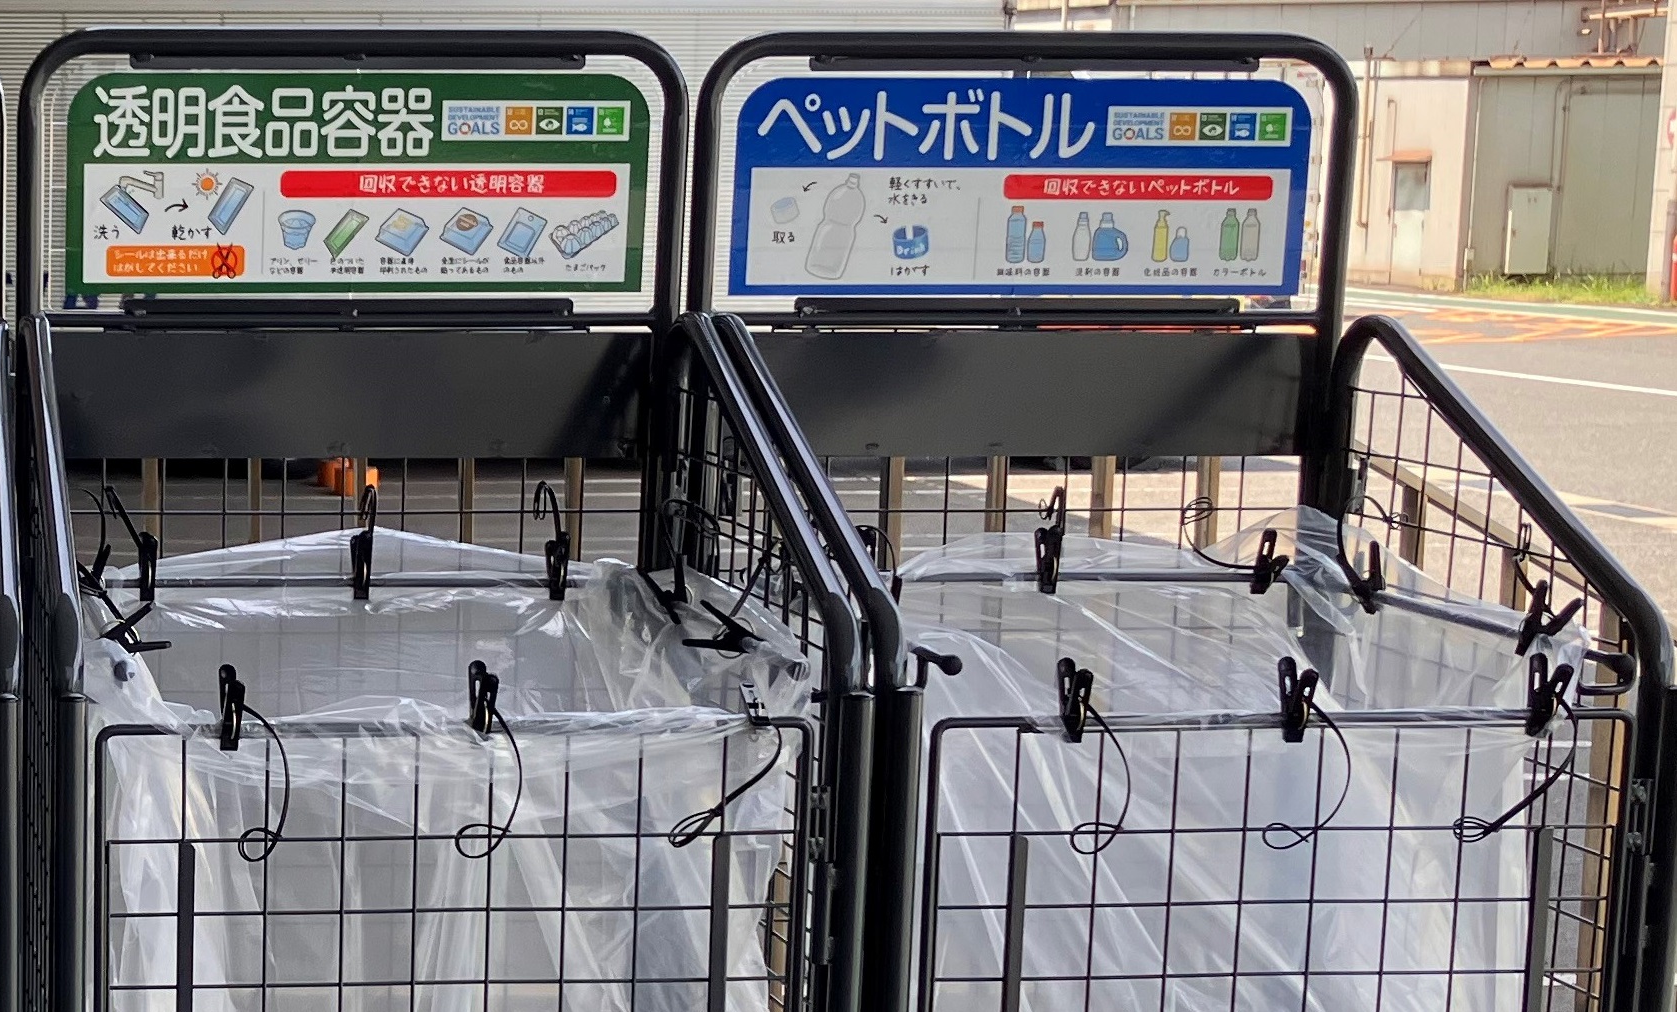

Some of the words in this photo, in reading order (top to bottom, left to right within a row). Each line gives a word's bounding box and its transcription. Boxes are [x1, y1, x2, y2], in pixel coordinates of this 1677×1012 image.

[94, 86, 434, 158] 透明食品容器
[447, 122, 500, 135] GOALS
[757, 88, 1095, 160] ペットボトル
[1112, 127, 1165, 140] GOALS
[359, 174, 545, 194] 回収できない透明容器
[1043, 178, 1239, 196] 回収できないペットボトル
[93, 224, 121, 240] 洗う
[172, 224, 212, 241] 乾かす
[772, 231, 795, 244] 取る
[113, 249, 208, 261] シールは出来るだけ
[113, 263, 198, 274] はがしてください
[890, 265, 930, 276] はがす
